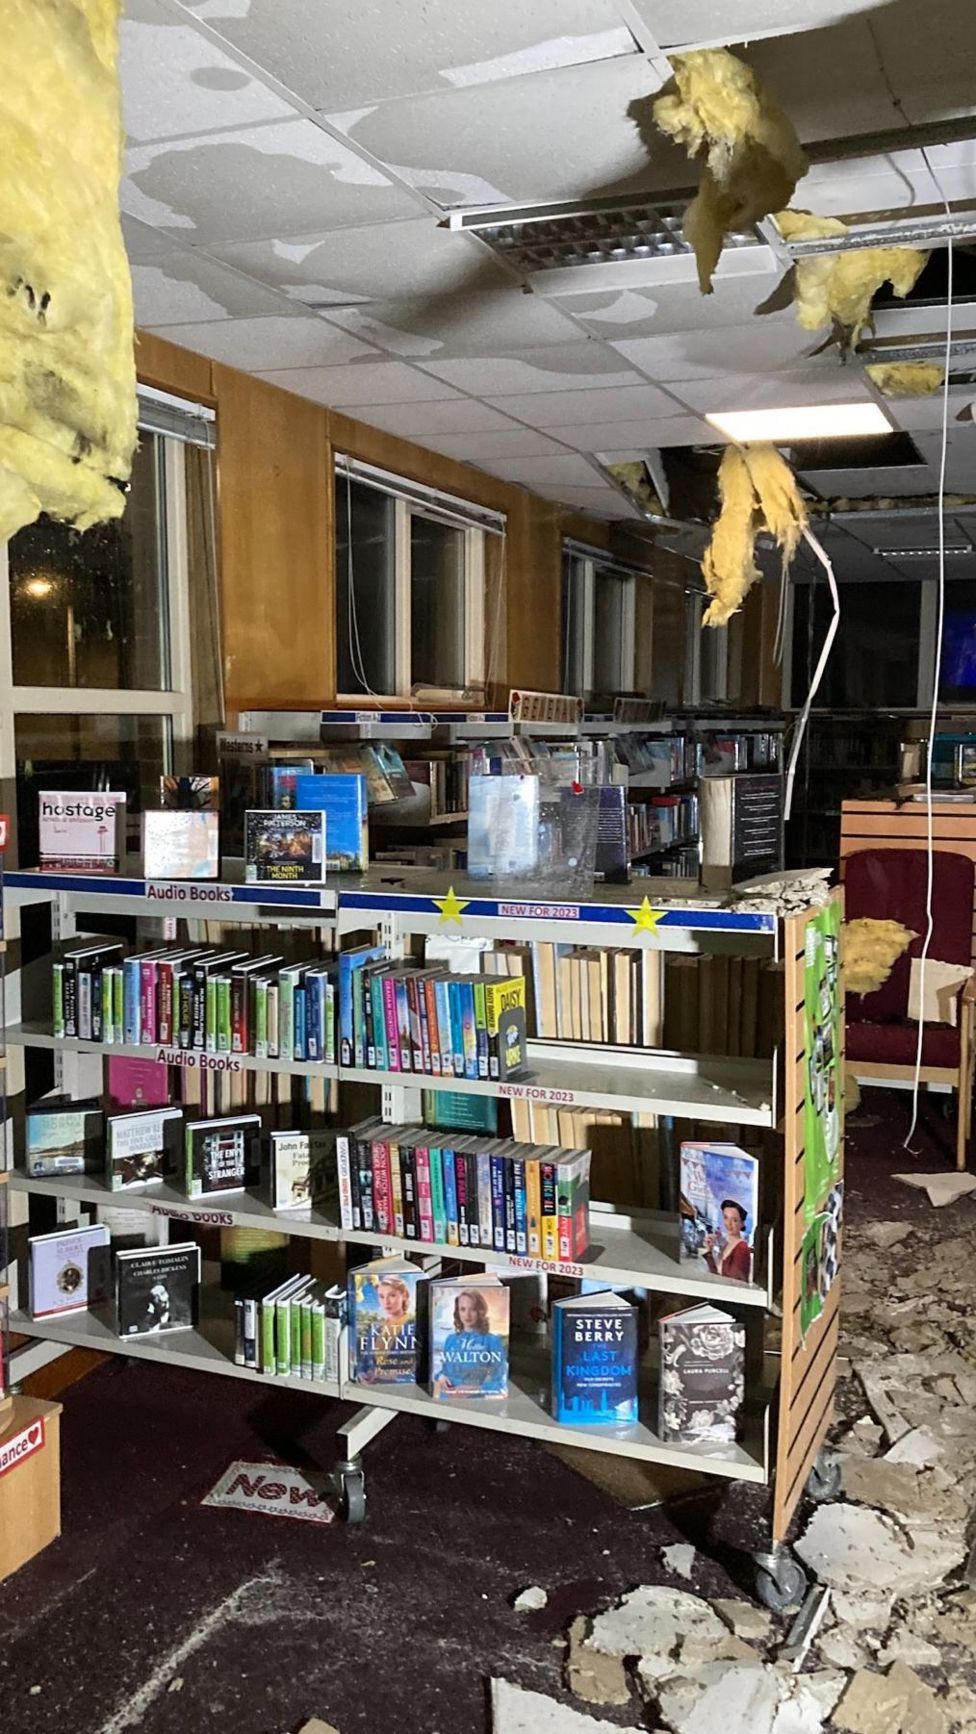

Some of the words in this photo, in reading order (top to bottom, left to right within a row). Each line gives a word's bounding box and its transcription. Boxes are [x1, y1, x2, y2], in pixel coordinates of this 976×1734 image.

[219, 737, 254, 753] Westerns
[42, 802, 116, 821] hostage
[266, 865, 281, 873] THE
[281, 865, 305, 873] NINTH
[147, 884, 187, 901] Audio
[190, 886, 231, 902] Books
[501, 904, 527, 917] NEW
[529, 906, 549, 917] FOR
[551, 907, 578, 919] 2023
[501, 988, 521, 1012] DAISY
[157, 1049, 196, 1066] Audio
[200, 1054, 240, 1071] Books
[499, 1085, 524, 1099] NEW
[526, 1088, 546, 1100] FOR
[548, 1089, 574, 1102] 2023
[278, 1142, 297, 1151] John
[210, 1149, 224, 1160] THE
[208, 1166, 246, 1180] STRANGER
[456, 1157, 465, 1177] DOG
[543, 1165, 555, 1197] MONICA
[457, 1180, 467, 1205] PARK
[546, 1200, 555, 1213] ALI
[130, 1260, 156, 1268] CLAIRE
[158, 1256, 189, 1265] TOMALIN
[509, 1256, 533, 1268] NEW
[535, 1259, 556, 1271] FOR
[559, 1263, 584, 1276] 2023
[133, 1268, 160, 1277] CHARLES
[161, 1265, 187, 1273] DICKENS
[371, 1323, 415, 1336] KATIE
[576, 1319, 623, 1329] STEVE
[360, 1337, 419, 1350] FLYNN
[575, 1331, 624, 1342] BERRY
[440, 1351, 502, 1363] WALTON
[583, 1351, 617, 1362] LAST
[566, 1364, 632, 1377] KINGDOM
[0, 1439, 28, 1469] ance
[226, 1473, 321, 1507] New
